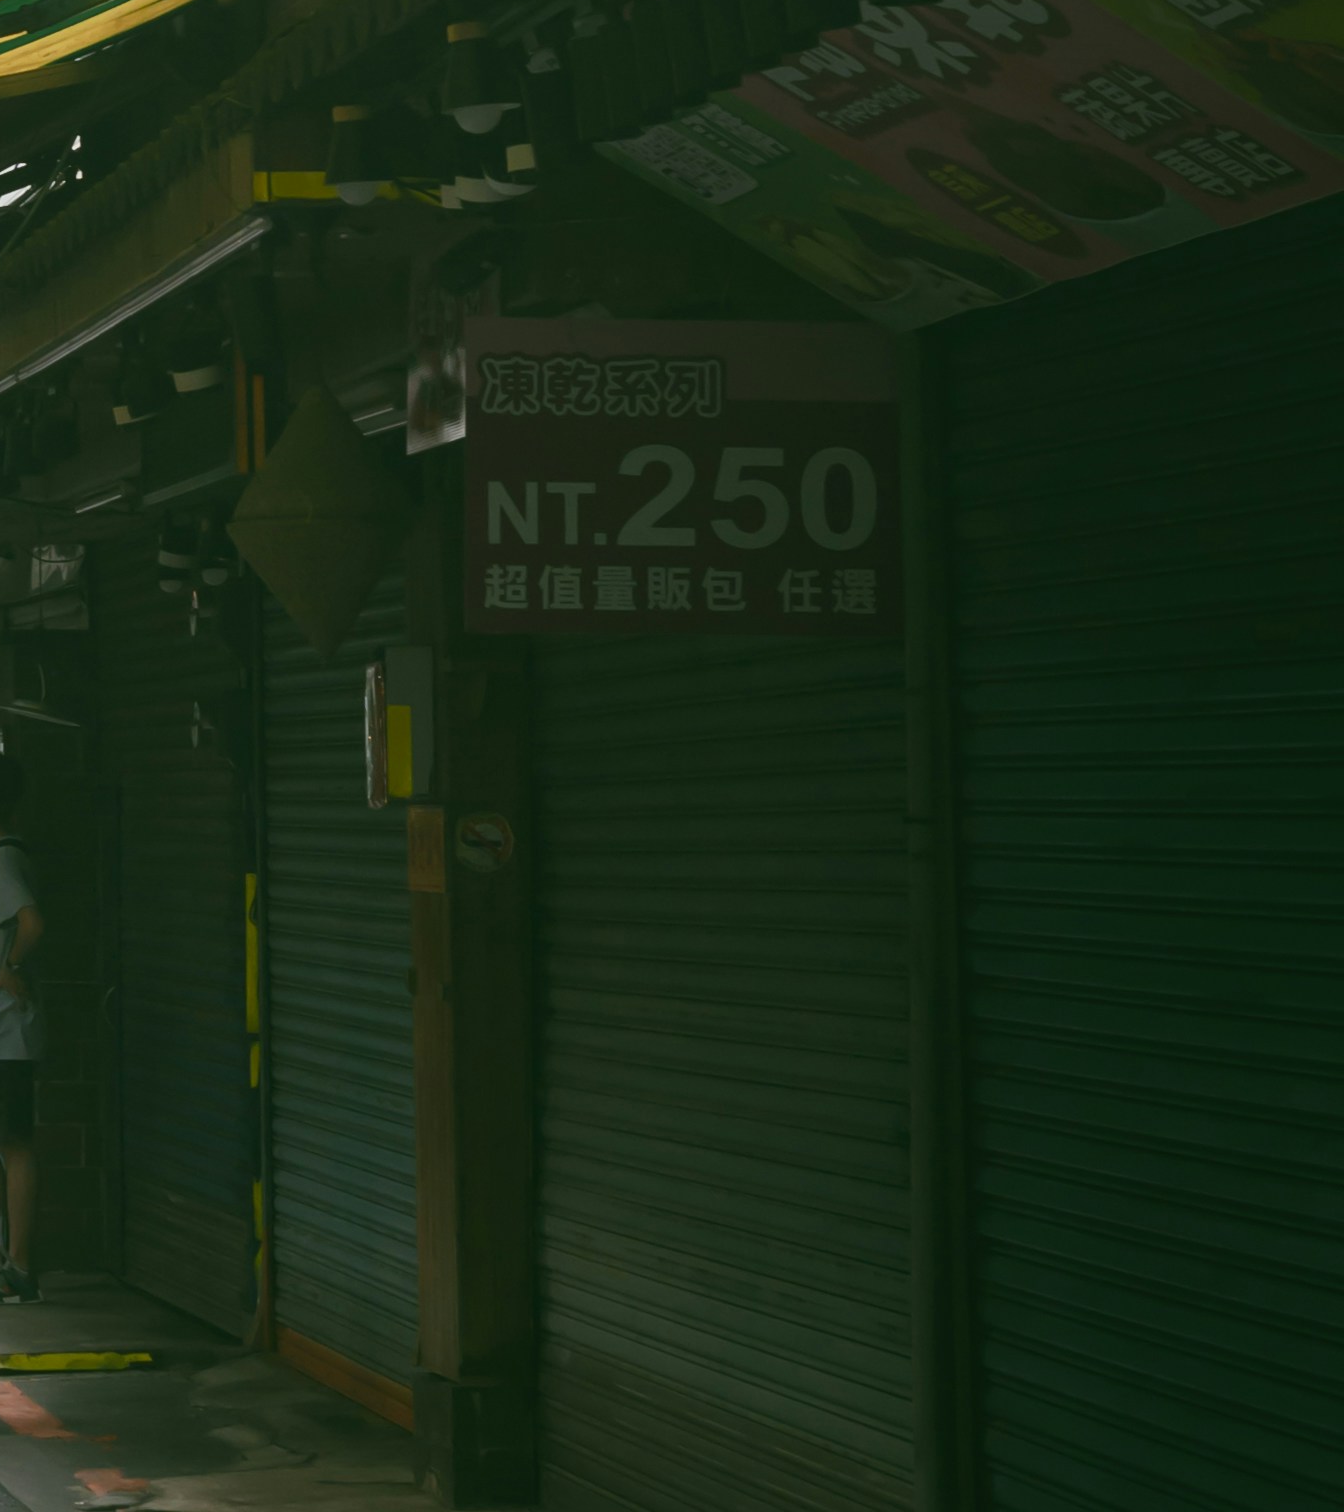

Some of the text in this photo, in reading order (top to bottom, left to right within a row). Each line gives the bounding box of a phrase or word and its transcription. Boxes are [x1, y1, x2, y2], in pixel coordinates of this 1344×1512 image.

[1058, 63, 1201, 141] 蔬果片
[1152, 127, 1295, 197] 專賣店
[480, 355, 724, 417] 凍乾系列
[486, 444, 878, 551] NT.250
[483, 565, 878, 614] 超值量販包 任選
